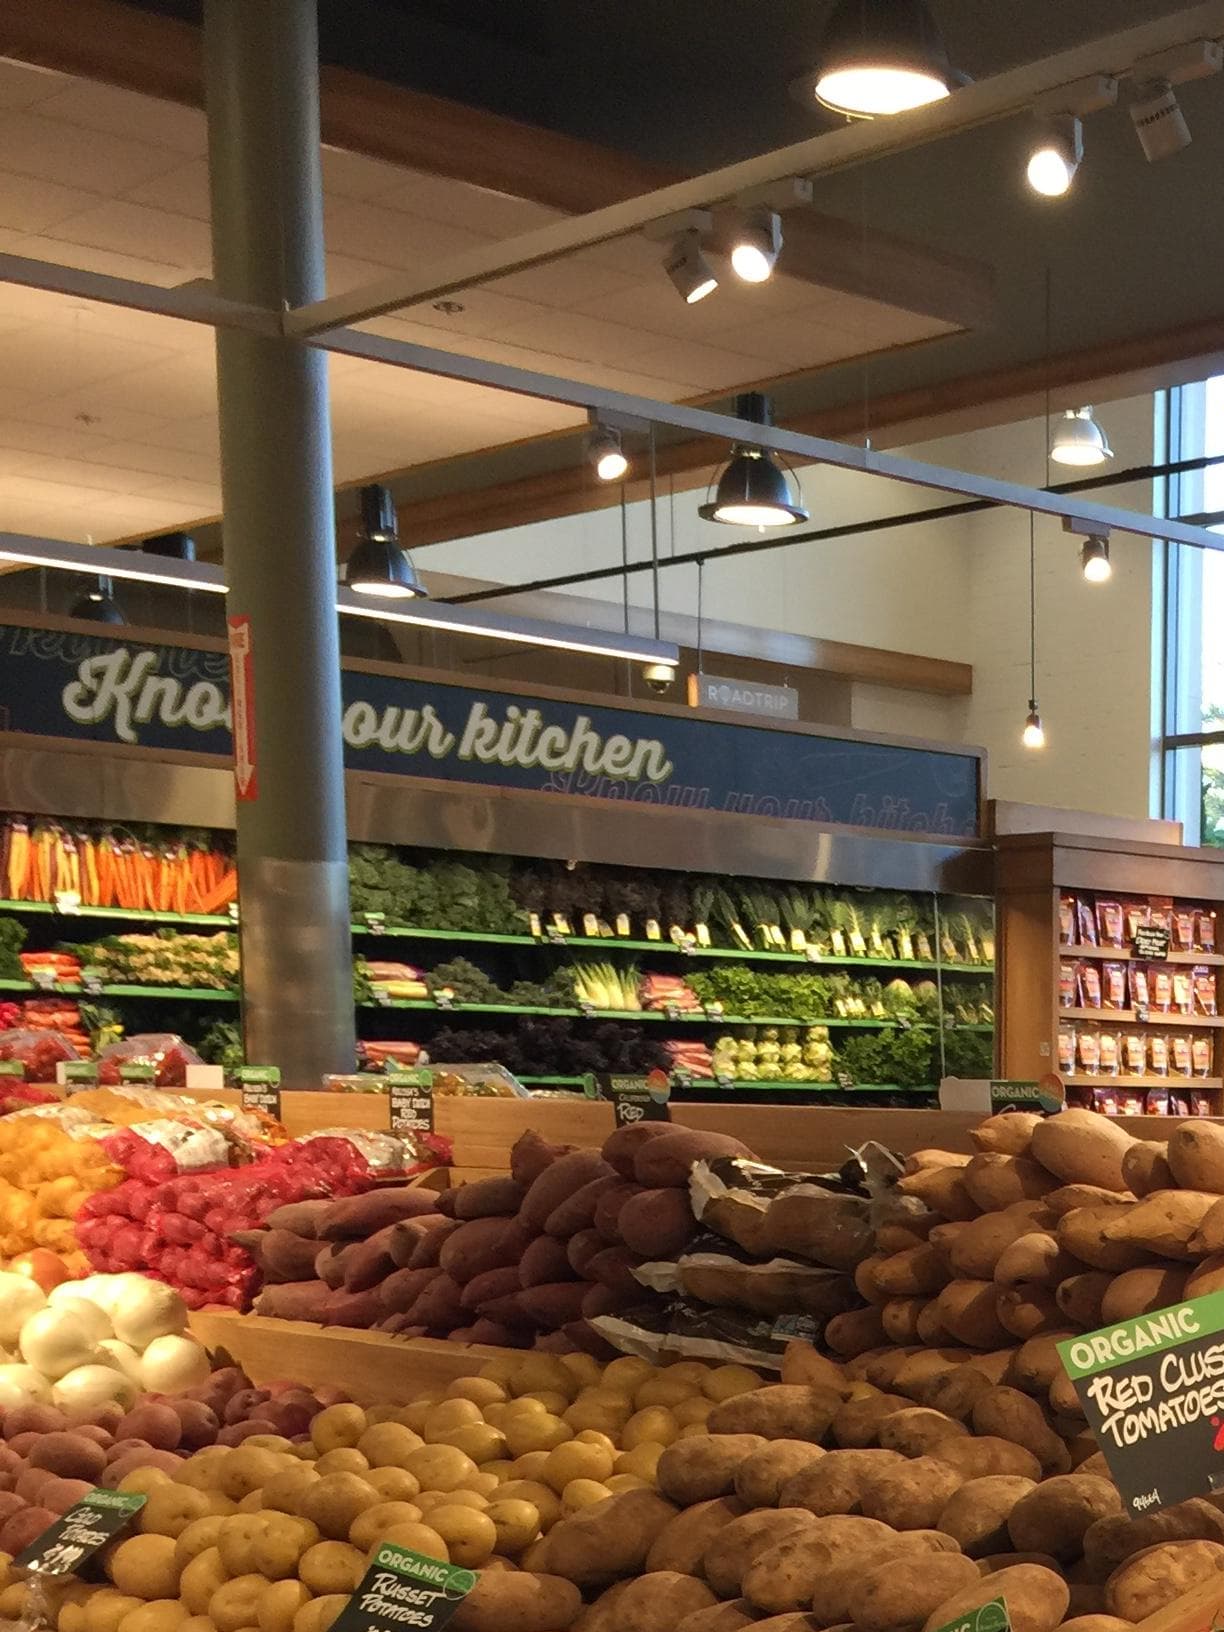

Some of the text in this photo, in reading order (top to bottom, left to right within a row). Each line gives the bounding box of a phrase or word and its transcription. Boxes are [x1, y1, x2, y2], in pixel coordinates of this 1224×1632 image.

[707, 684, 789, 711] ROADTRIP
[62, 648, 233, 743] Kno
[341, 701, 456, 760] our
[457, 702, 674, 783] kitchen
[992, 1085, 1039, 1099] ORGANIC
[1070, 1307, 1201, 1370] ORGANIC
[1087, 1374, 1154, 1416] RED
[378, 1550, 449, 1583] ORGANIC
[371, 1572, 448, 1607] RUSSET
[360, 1593, 435, 1628] POTATOES
